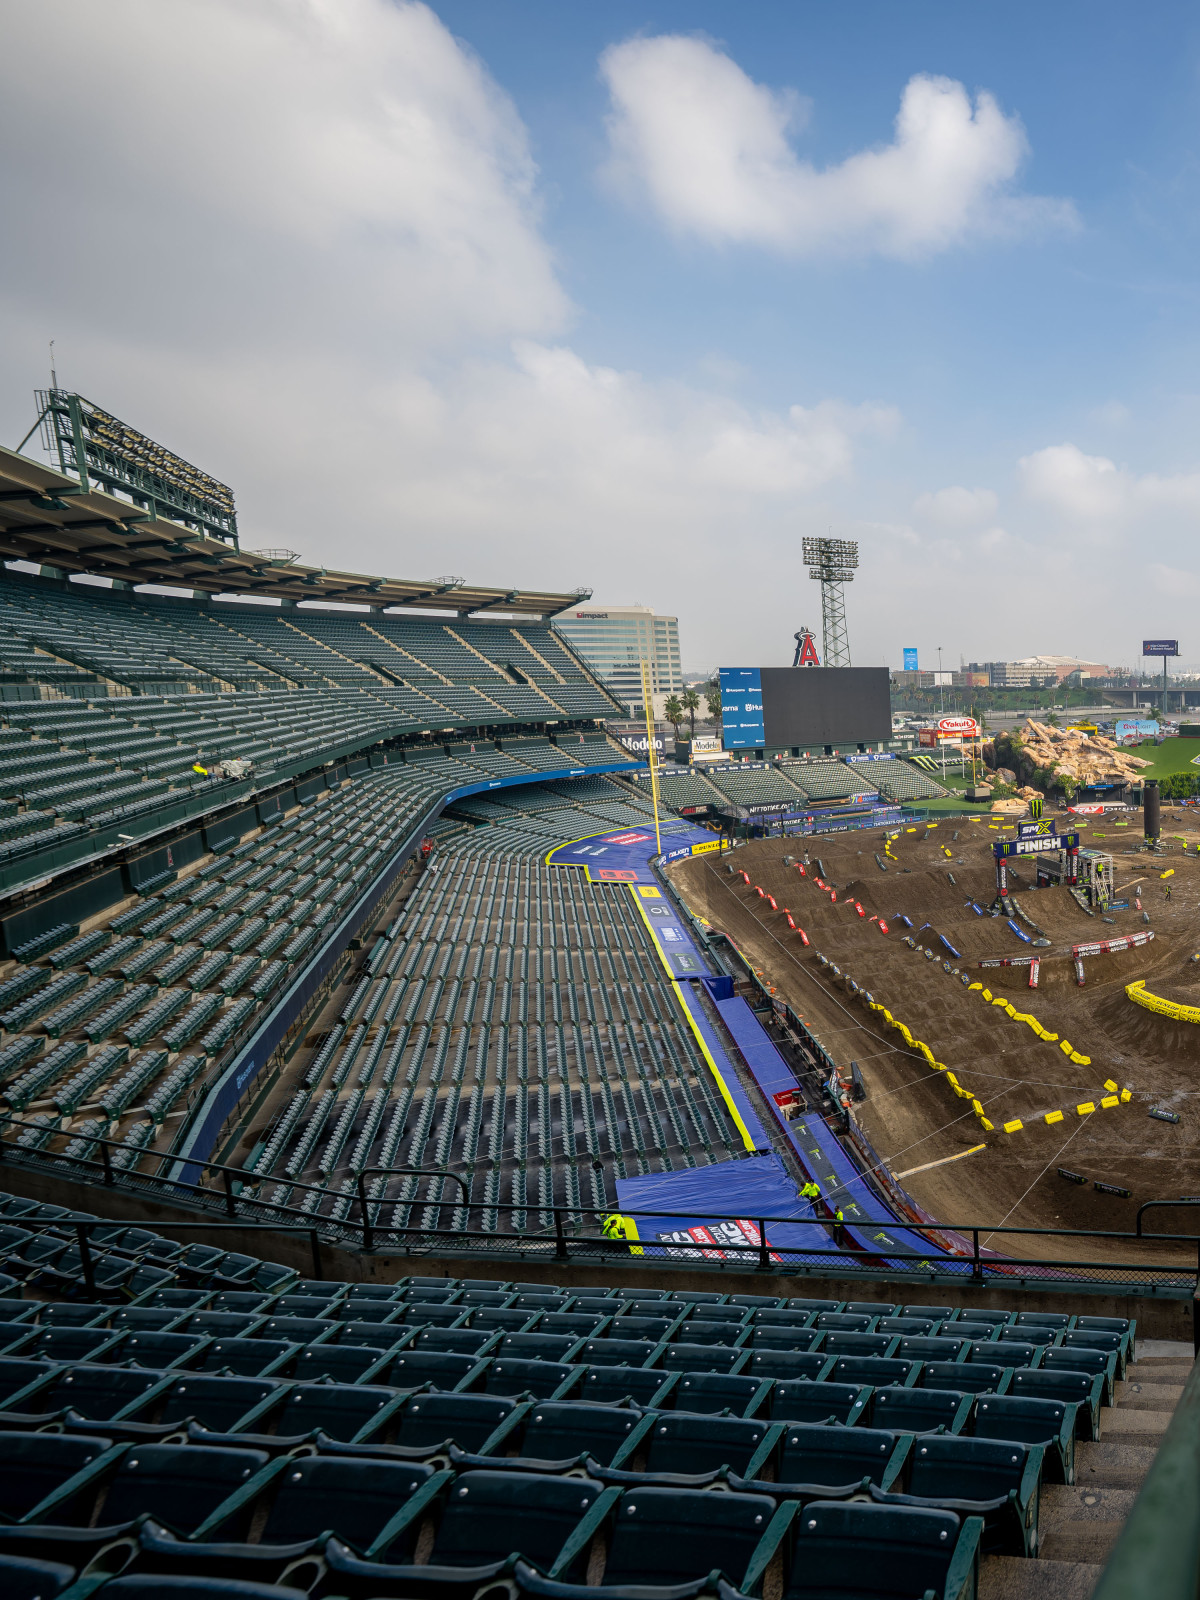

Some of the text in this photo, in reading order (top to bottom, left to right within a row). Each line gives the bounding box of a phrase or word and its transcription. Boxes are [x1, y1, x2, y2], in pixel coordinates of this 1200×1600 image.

[622, 737, 662, 750] Modelo
[695, 741, 718, 749] Modelo
[1022, 821, 1051, 834] SMX
[1016, 838, 1061, 854] FINISH
[1156, 1000, 1180, 1011] DUNLOP
